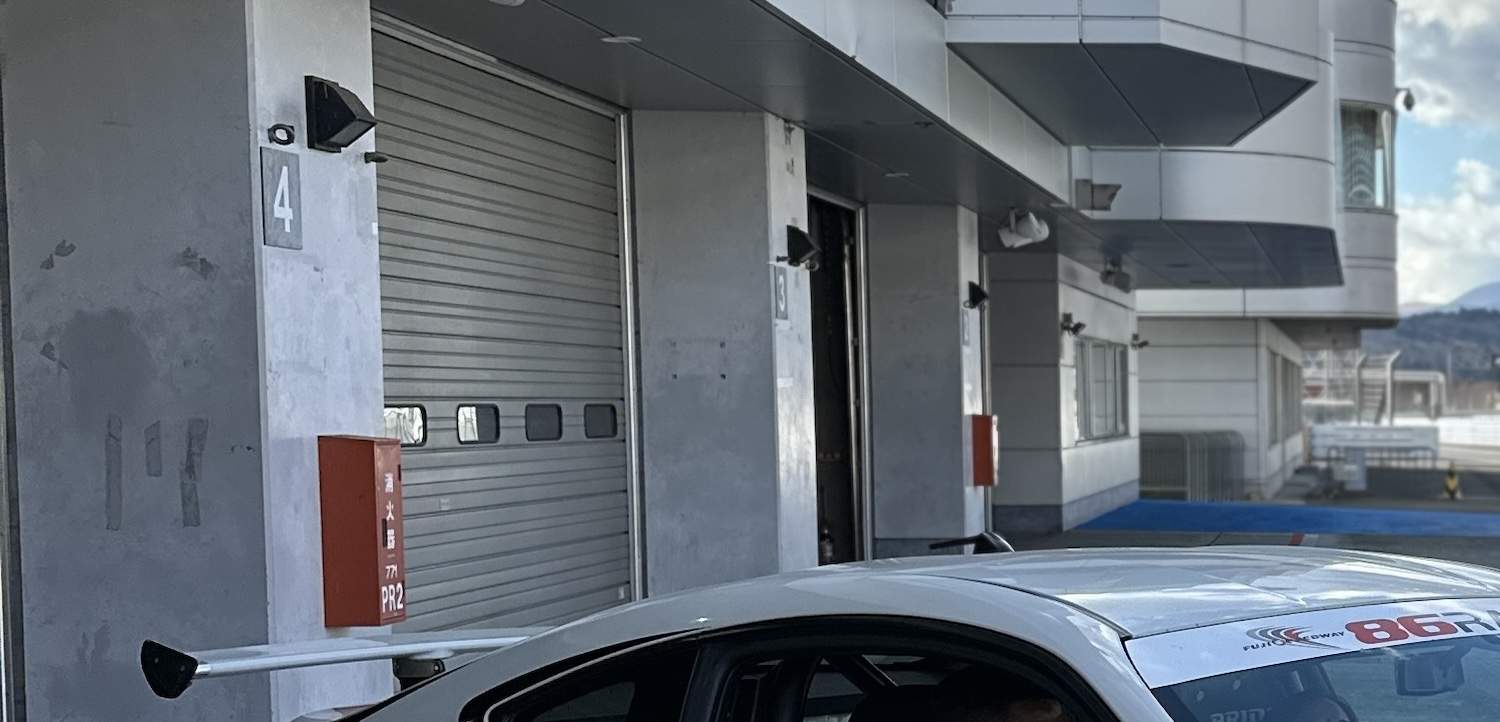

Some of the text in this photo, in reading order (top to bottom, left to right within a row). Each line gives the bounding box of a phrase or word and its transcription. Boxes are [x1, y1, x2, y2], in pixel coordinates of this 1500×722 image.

[273, 166, 294, 233] 4
[778, 274, 786, 312] 3
[381, 582, 404, 613] PR2
[1243, 640, 1272, 651] FUJI
